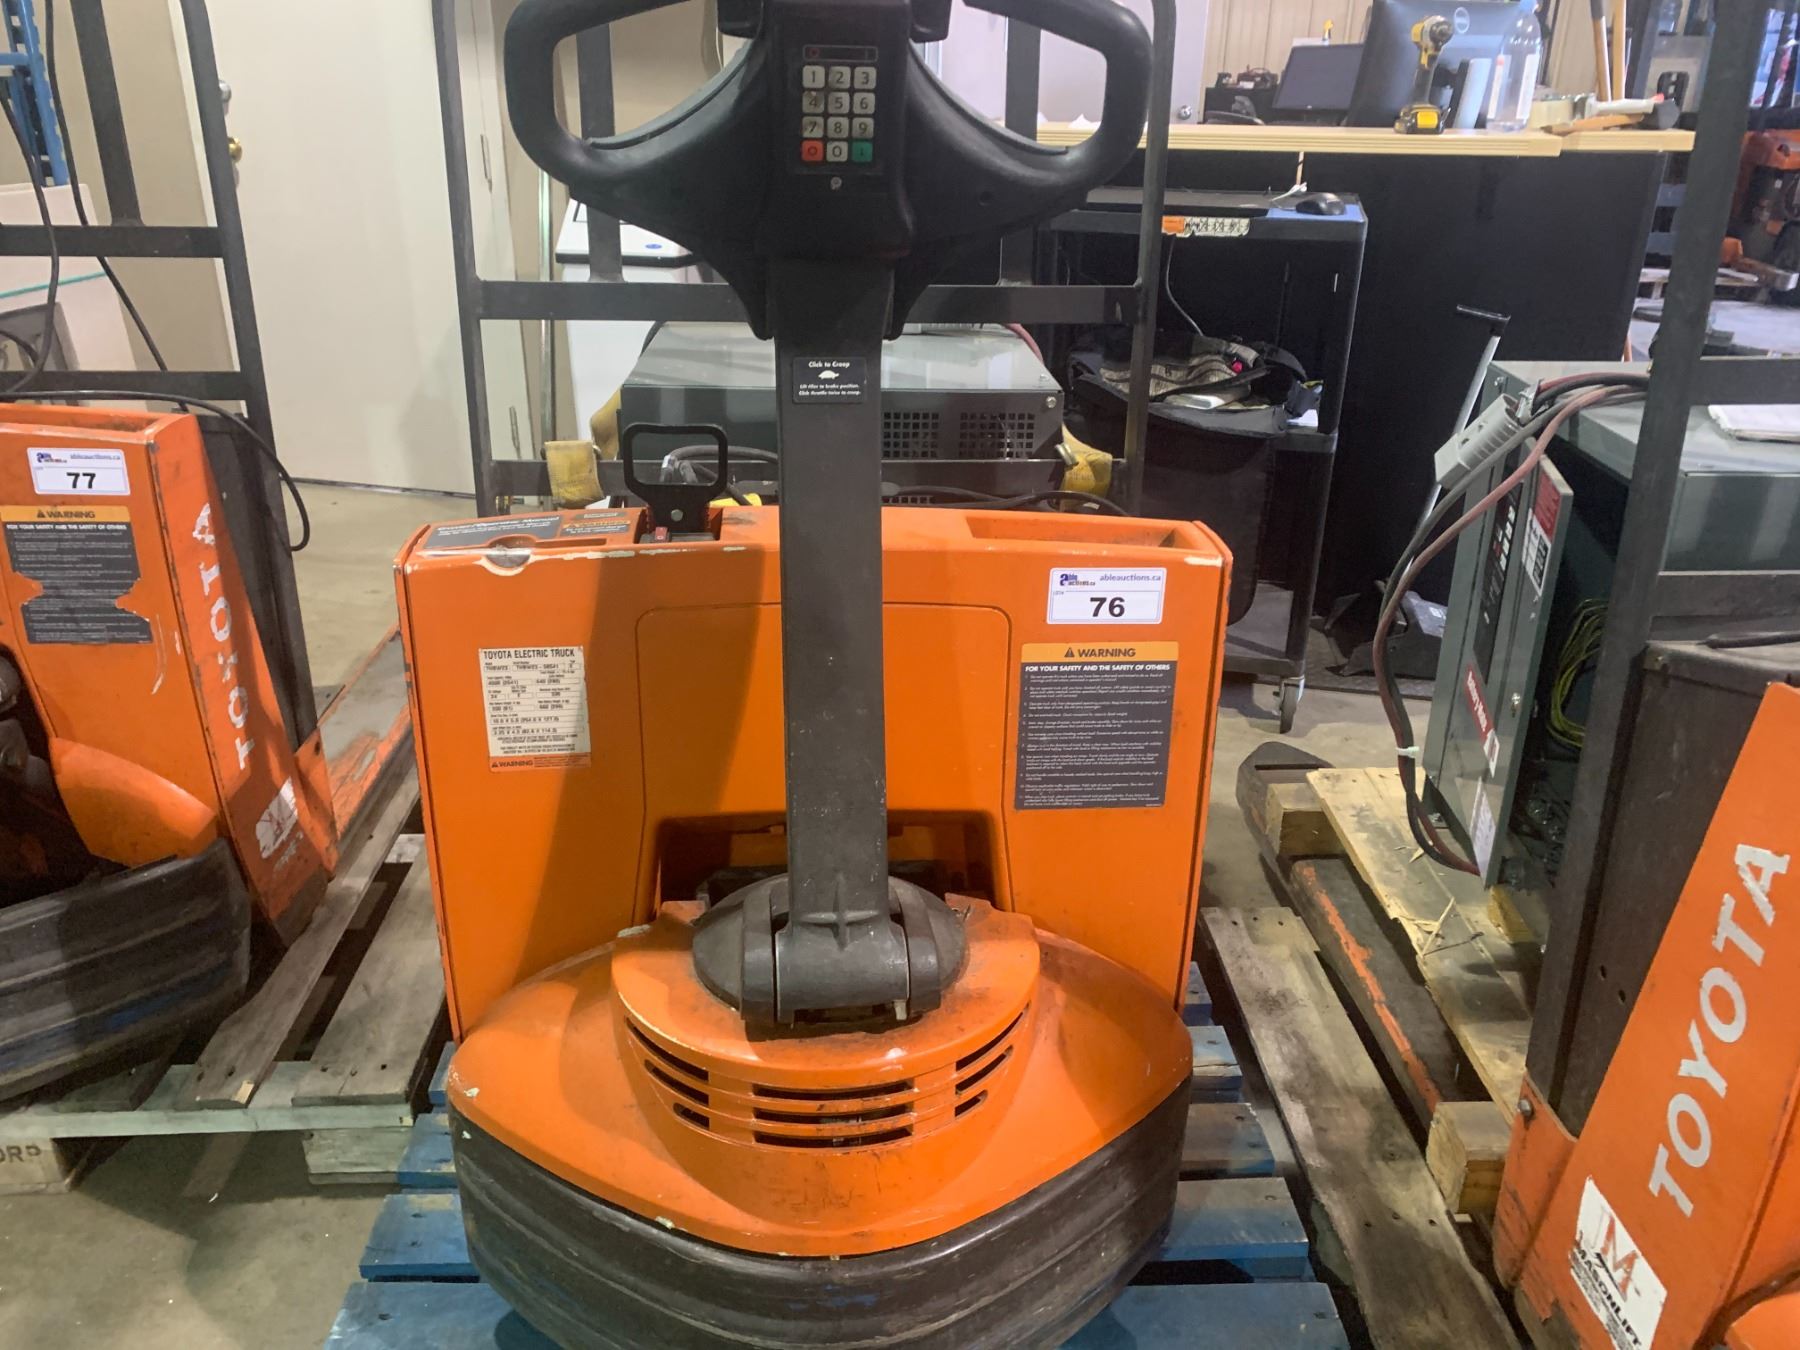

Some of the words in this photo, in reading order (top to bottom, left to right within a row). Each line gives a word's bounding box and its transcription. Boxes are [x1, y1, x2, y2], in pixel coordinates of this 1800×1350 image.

[836, 71, 844, 84] 2
[861, 72, 869, 85] 3
[835, 97, 843, 109] 5
[860, 97, 868, 109] 6
[809, 121, 817, 133] 7
[834, 122, 842, 133] 8
[859, 122, 867, 134] 9
[831, 361, 850, 369] Creep
[66, 472, 97, 489] 77
[48, 511, 96, 519] WARNING
[1099, 573, 1161, 581] ableauctions.ca
[1090, 597, 1125, 617] 76
[484, 650, 512, 660] TOYOTA
[514, 650, 549, 659] ELECTRIC
[550, 648, 575, 658] TRUCK
[1078, 648, 1136, 658] WARNING
[1649, 844, 1790, 1218] TOYOTA
